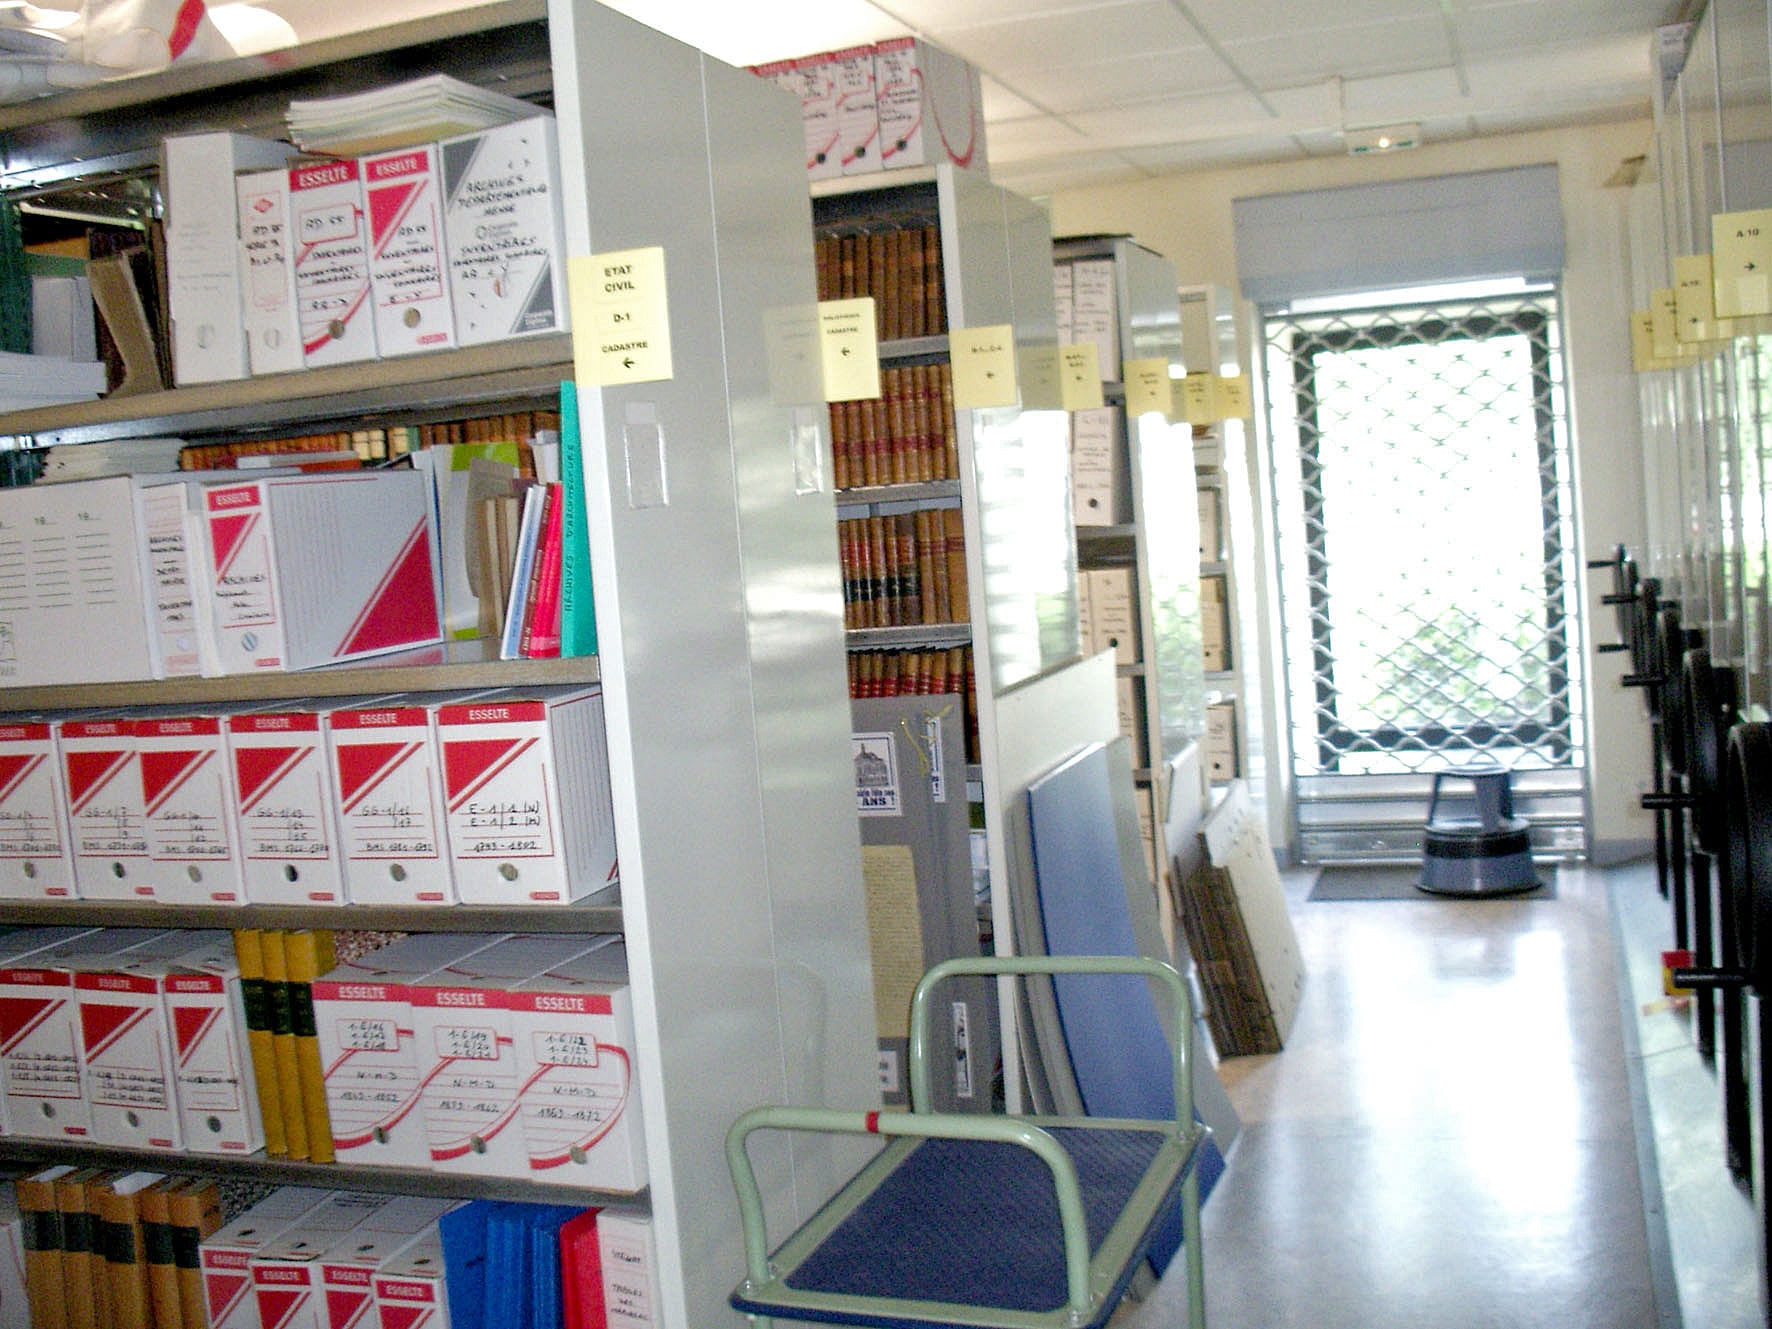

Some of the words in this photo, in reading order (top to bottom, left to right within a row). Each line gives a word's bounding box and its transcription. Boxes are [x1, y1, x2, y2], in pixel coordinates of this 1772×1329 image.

[375, 159, 417, 176] ESSELTE
[298, 165, 349, 187] ESSELTE
[604, 265, 632, 276] ETAT
[604, 281, 635, 292] CIVIL
[602, 340, 648, 353] CADASTRE
[215, 493, 252, 505] ESSELTE
[564, 555, 574, 612] ARCHIVES
[359, 713, 398, 725] ESSELTE
[468, 708, 509, 720] ESSELTE
[159, 722, 193, 733] ESSELTE
[255, 717, 291, 729] ESSELTE
[338, 986, 386, 1000] ESSELTE
[435, 992, 486, 1006] ESSELTE
[535, 996, 586, 1011] ESSELTE
